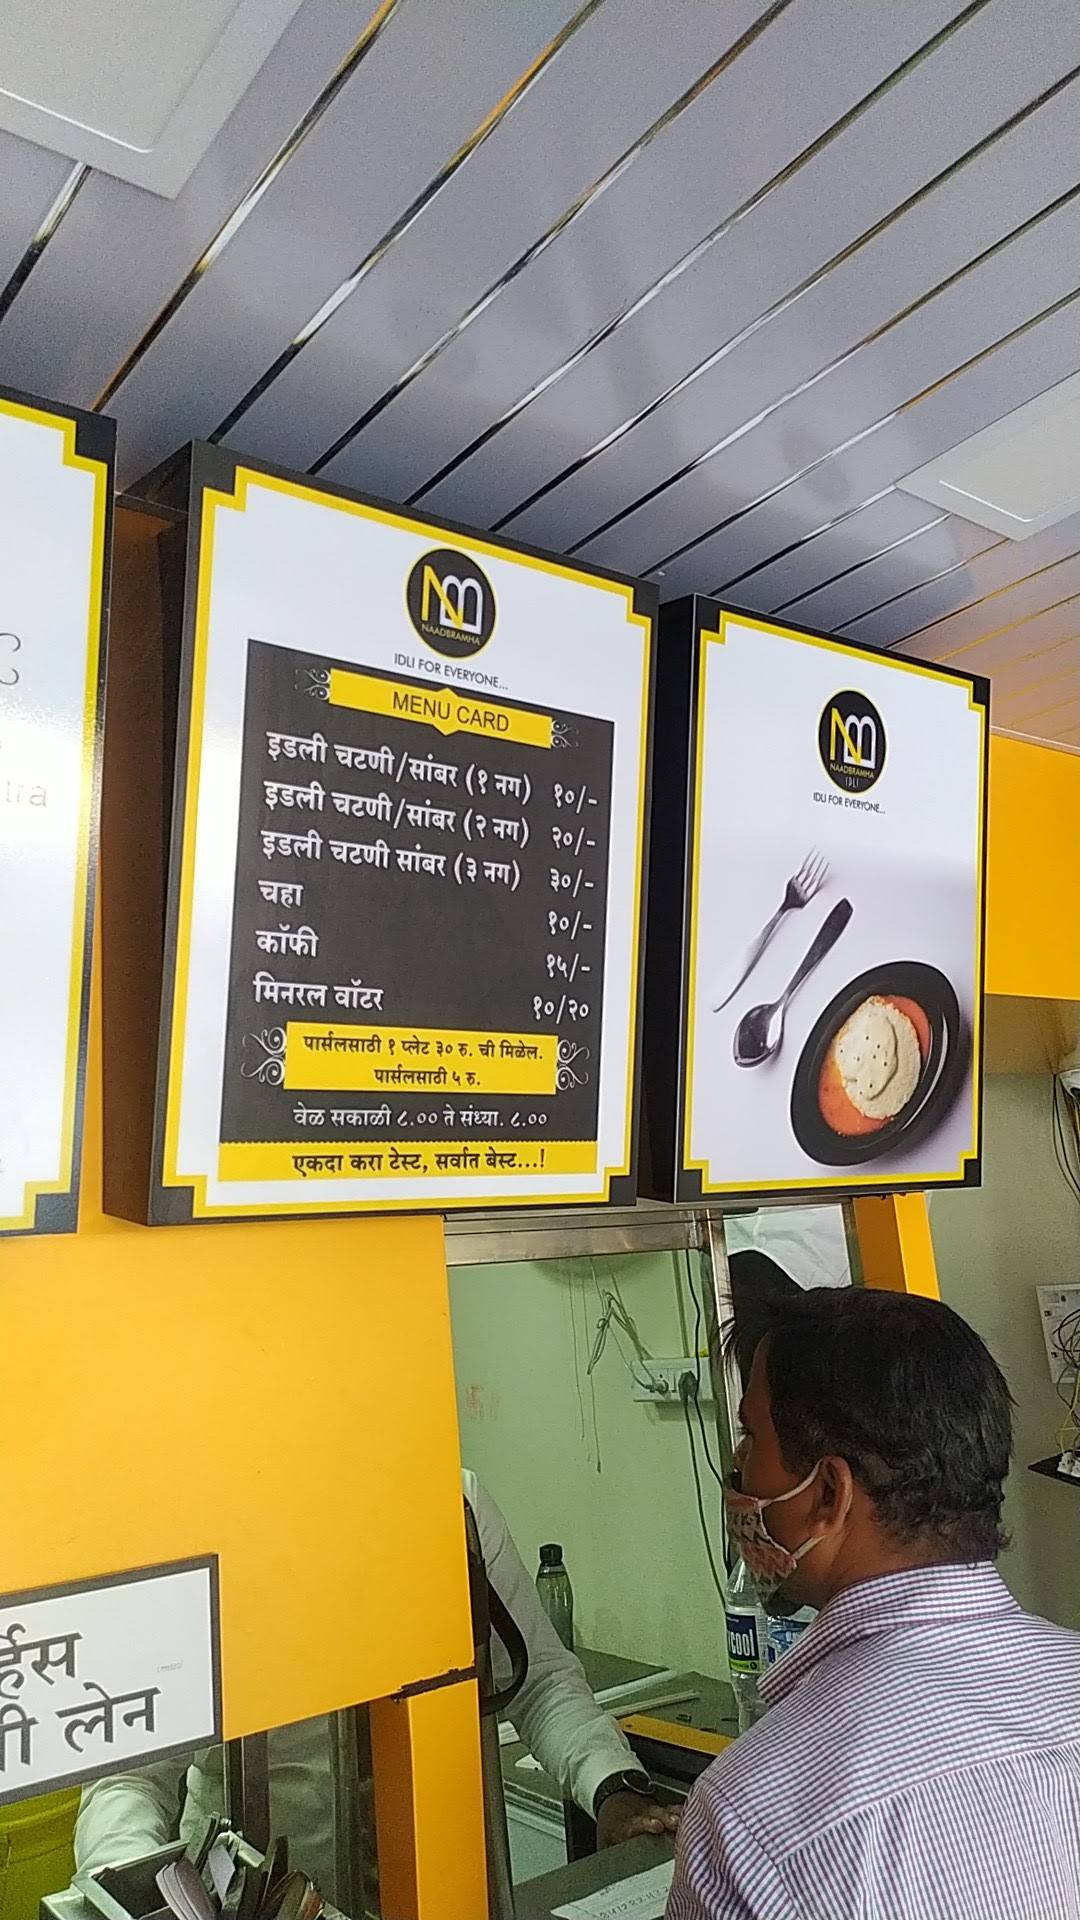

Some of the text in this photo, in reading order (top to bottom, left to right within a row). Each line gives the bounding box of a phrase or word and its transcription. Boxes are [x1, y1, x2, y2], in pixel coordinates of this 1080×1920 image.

[421, 623, 481, 646] NAADBRAMHA
[394, 653, 509, 690] IDLI FOR EVERYONE...
[393, 691, 510, 732] MENU CARD
[266, 732, 328, 763] इडली
[466, 764, 488, 797] (१
[494, 774, 531, 805] नग)
[554, 783, 597, 814] १०/-
[263, 780, 326, 811] इडली
[463, 808, 486, 841] (२
[492, 817, 529, 848] नग)
[552, 827, 595, 856] २०/-
[813, 792, 826, 803] IDLI
[828, 795, 842, 806] FOR
[261, 829, 594, 898] इडली चटणी सांबर (३ नग) ३०/-
[258, 880, 592, 940] चहा १०/-
[255, 923, 590, 983] कॉफी १५/-
[253, 971, 589, 1025] मिनरल वॉटर १०/२०
[304, 1031, 543, 1060] पार्सलसाठी १ प्लेट ३० रु. ची मिळेल.
[374, 1064, 481, 1086] पार्सलसाठी ५ रु.
[293, 1102, 548, 1127] वेळ सकाळी ८.०० ते संध्या. ८.००
[292, 1154, 343, 1177] एकदा
[349, 1154, 383, 1171] करा
[388, 1147, 428, 1173] टेस्ट,
[434, 1147, 480, 1170] सर्वात
[55, 1682, 161, 1753] लेन
